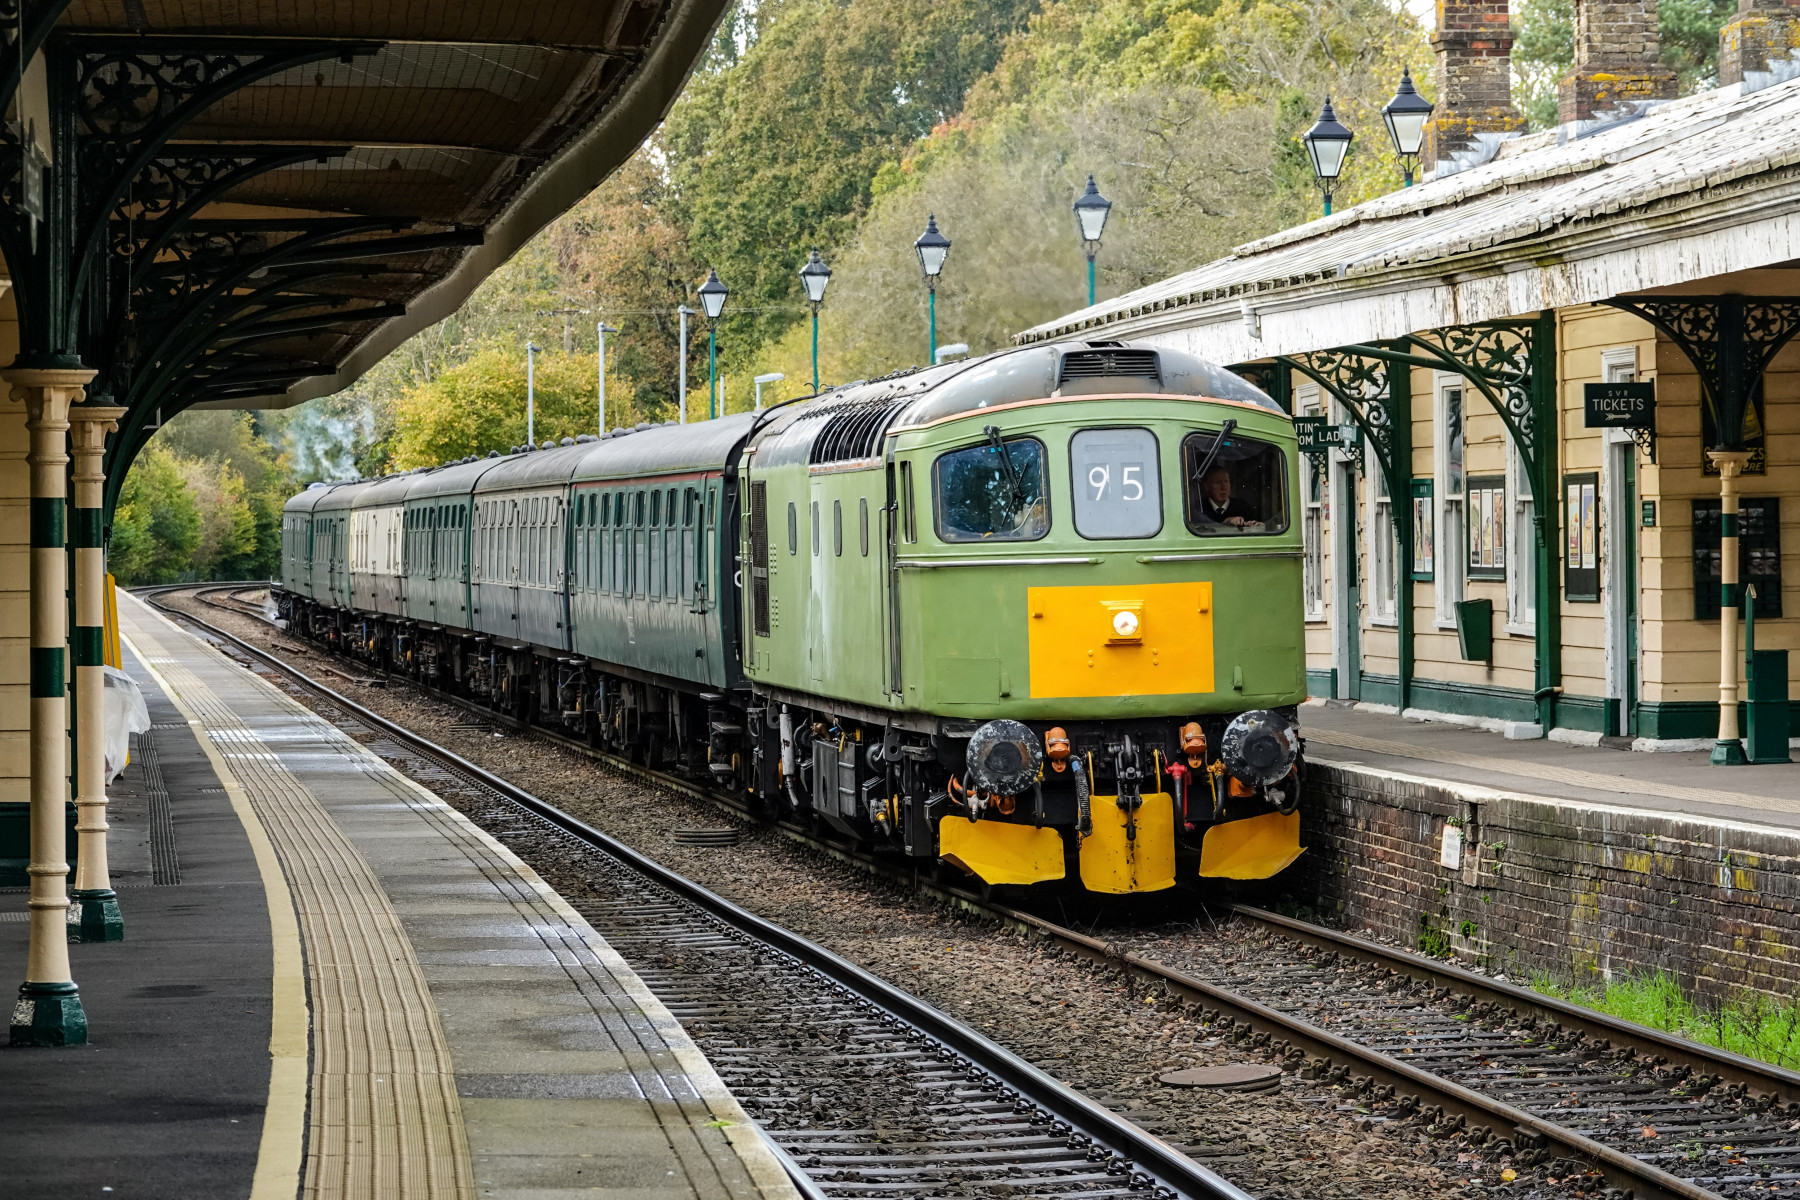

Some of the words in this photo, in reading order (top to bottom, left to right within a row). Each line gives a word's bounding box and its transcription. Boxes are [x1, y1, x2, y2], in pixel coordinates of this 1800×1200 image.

[1592, 398, 1644, 411] TICKETS
[1295, 423, 1320, 434] ITIN
[1298, 435, 1313, 446] OM
[1318, 431, 1343, 442] LAD
[1088, 464, 1144, 502] 95
